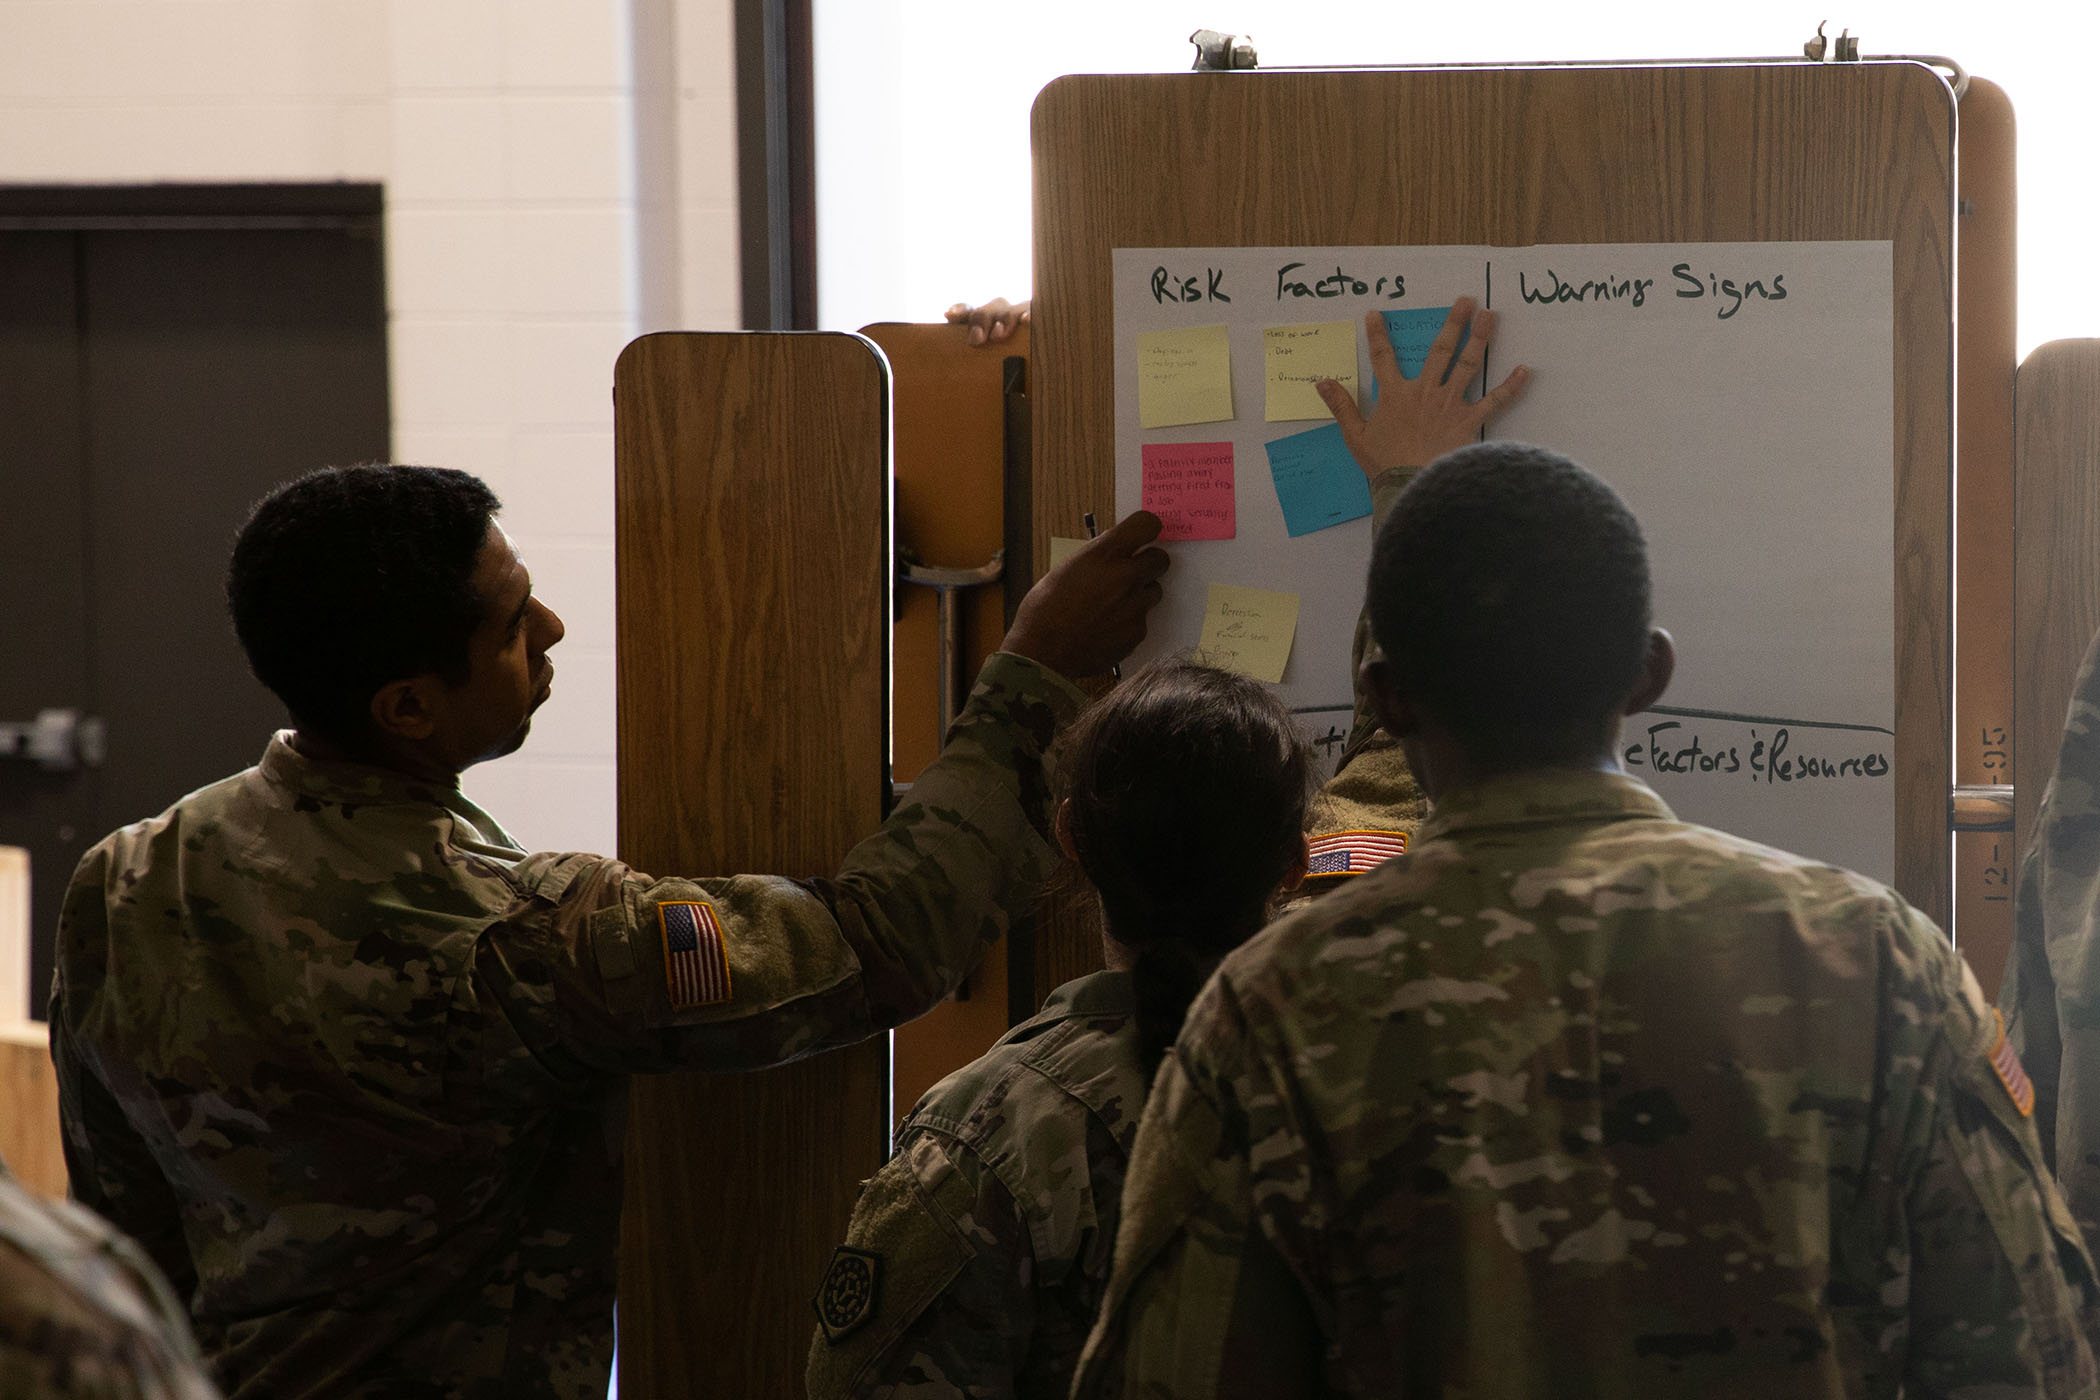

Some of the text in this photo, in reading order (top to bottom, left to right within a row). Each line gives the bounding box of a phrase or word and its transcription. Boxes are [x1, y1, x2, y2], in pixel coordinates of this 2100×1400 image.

[1151, 263, 1406, 304] Risk Factors
[1519, 263, 1788, 320] Warning Signs
[1388, 317, 1445, 332] ISOLATIO
[1647, 721, 1740, 773] Factors
[1767, 728, 1890, 784] Resources
